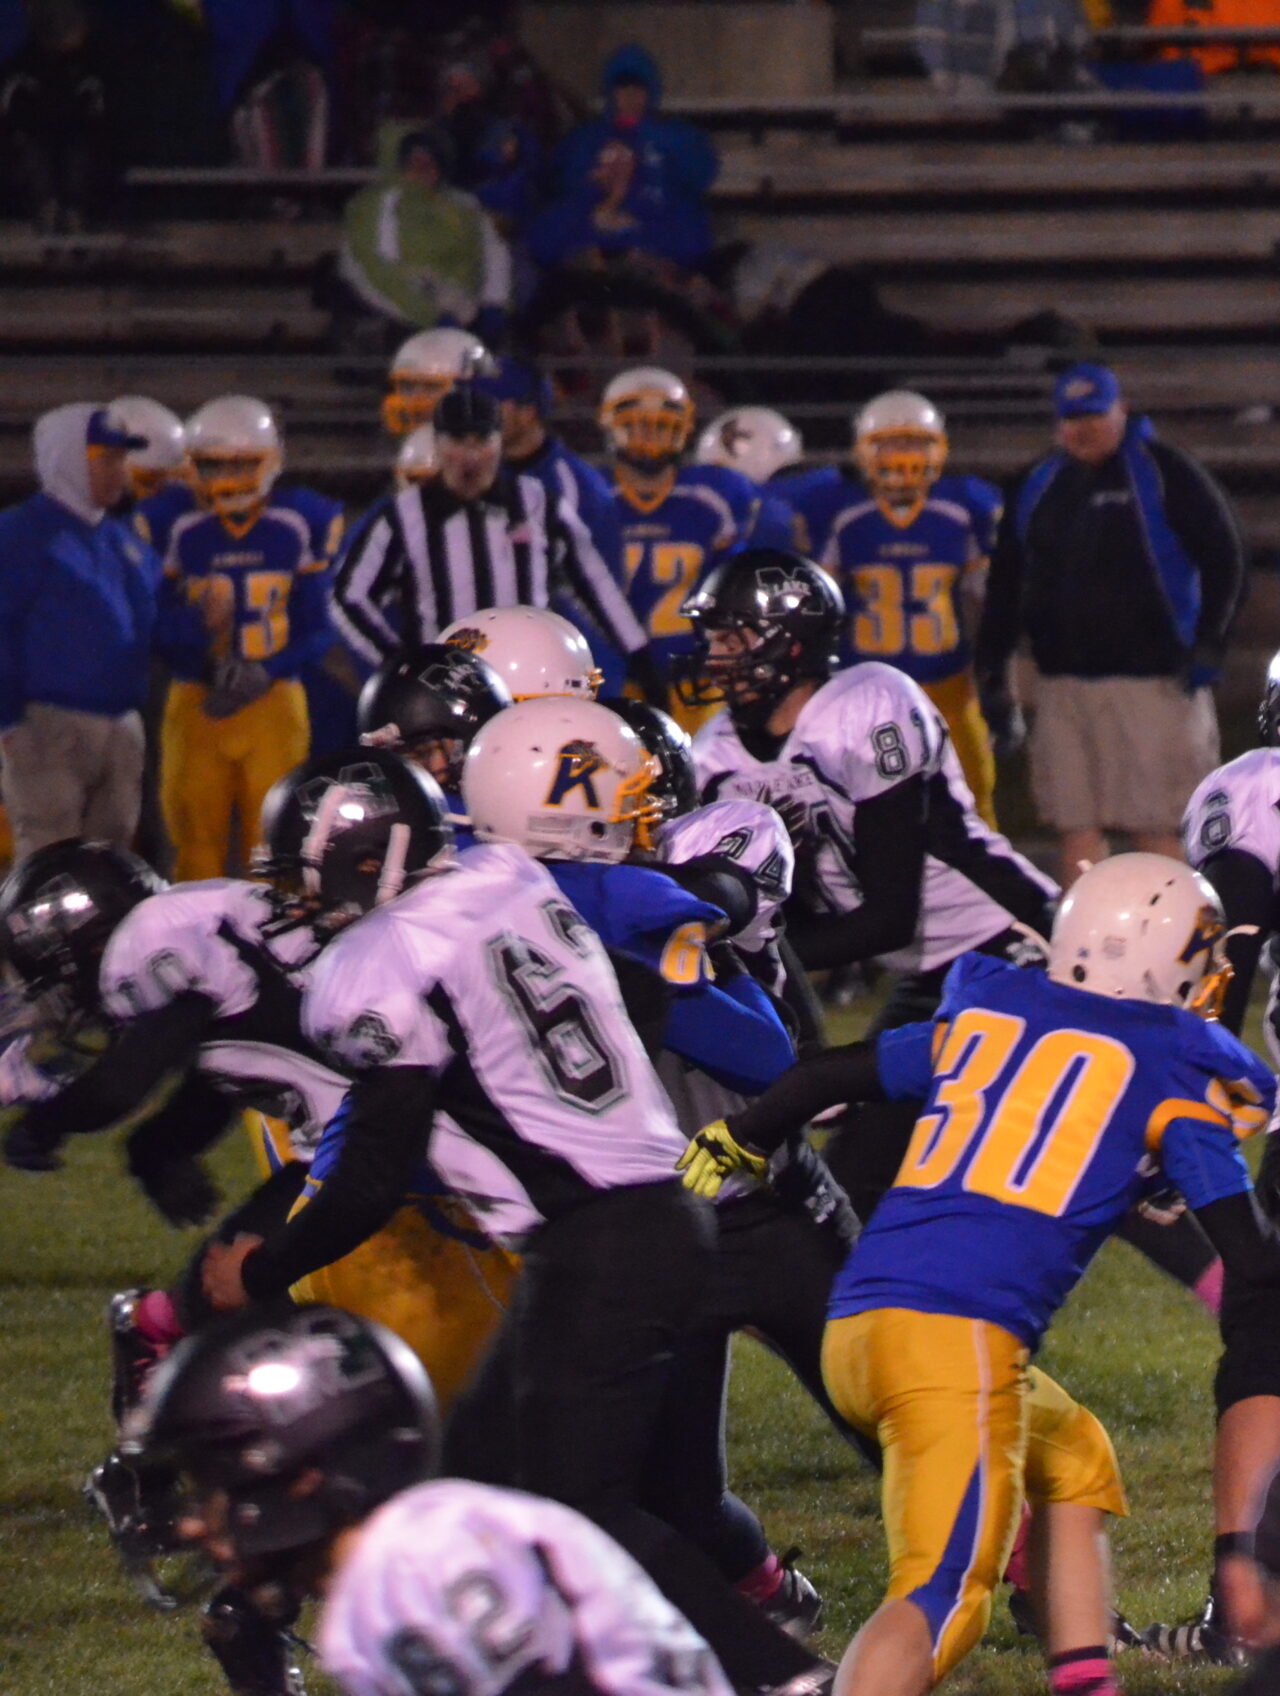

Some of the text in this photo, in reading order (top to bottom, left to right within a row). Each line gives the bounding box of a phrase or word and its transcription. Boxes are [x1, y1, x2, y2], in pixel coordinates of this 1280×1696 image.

[853, 563, 960, 656] 33
[660, 921, 716, 984] 6
[895, 1006, 1136, 1217] 30
